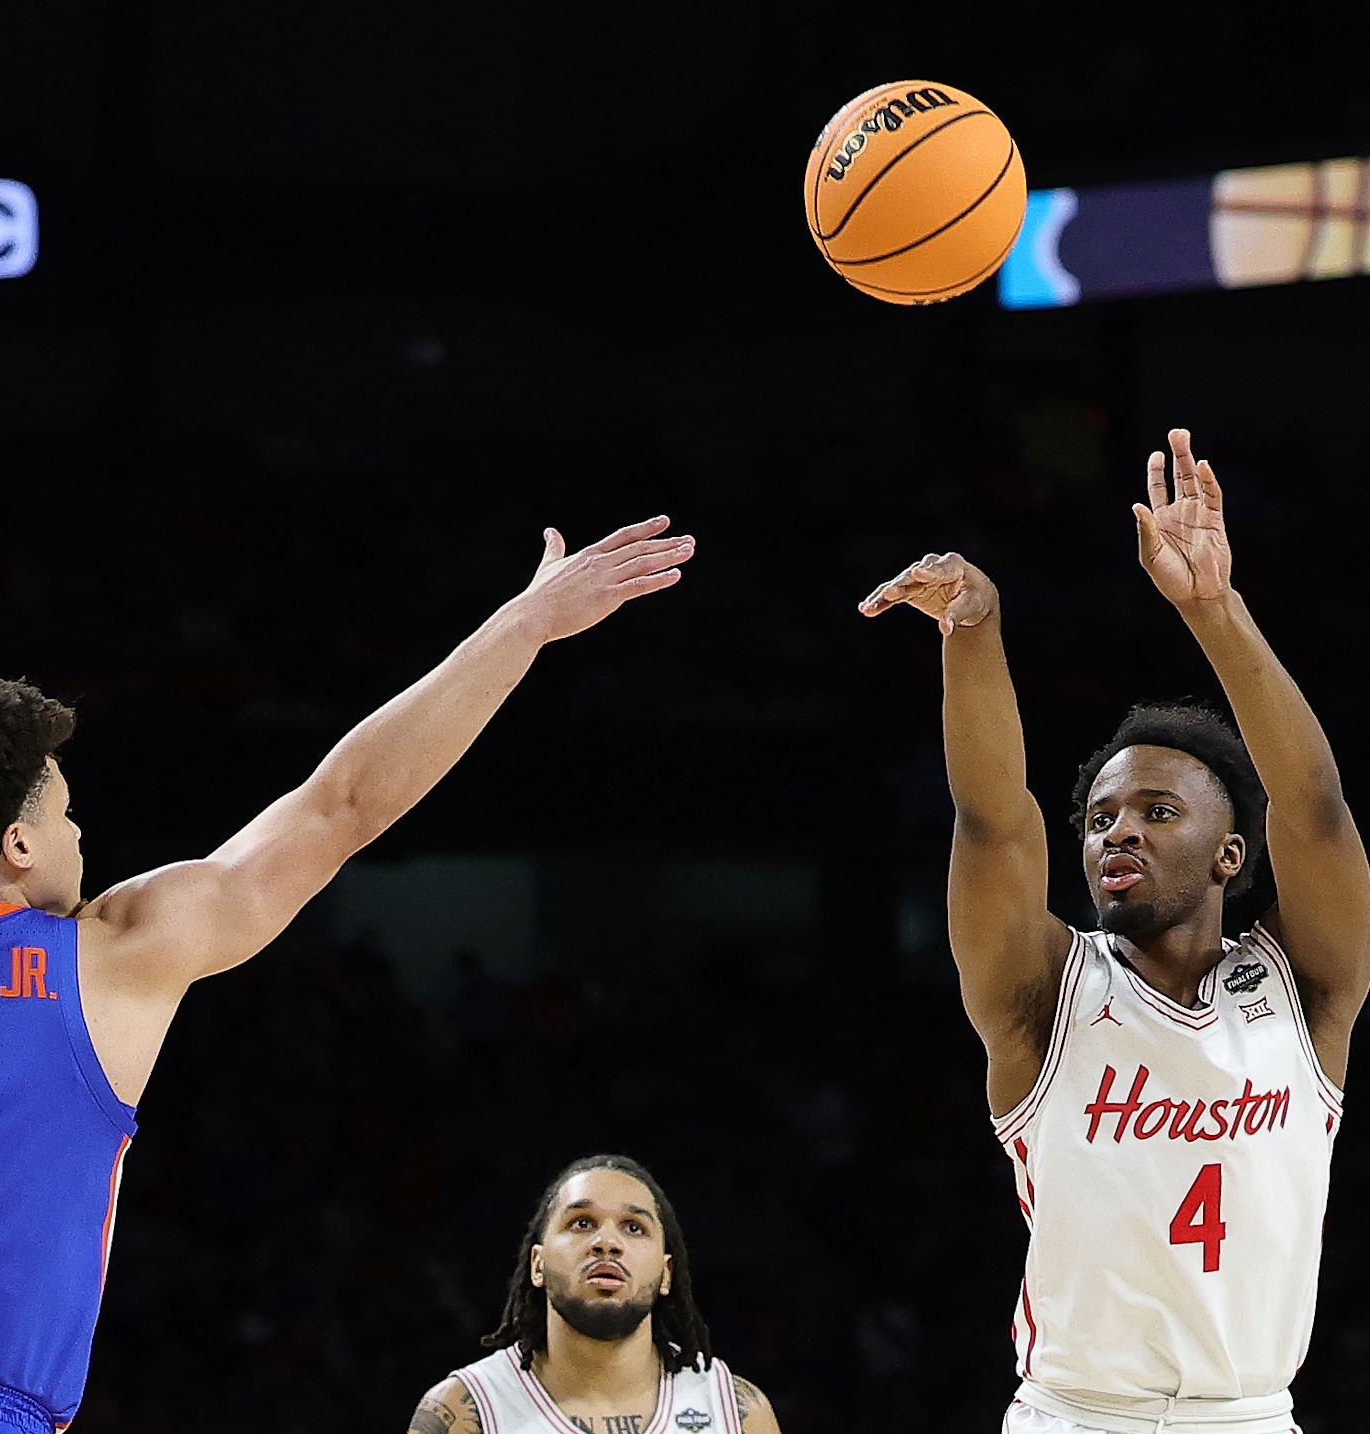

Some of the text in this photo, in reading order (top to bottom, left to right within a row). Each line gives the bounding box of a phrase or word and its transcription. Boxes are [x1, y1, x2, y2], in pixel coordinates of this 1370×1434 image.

[827, 88, 959, 181] Wilson
[1083, 1063, 1291, 1144] Houston
[1169, 1162, 1227, 1273] 4
